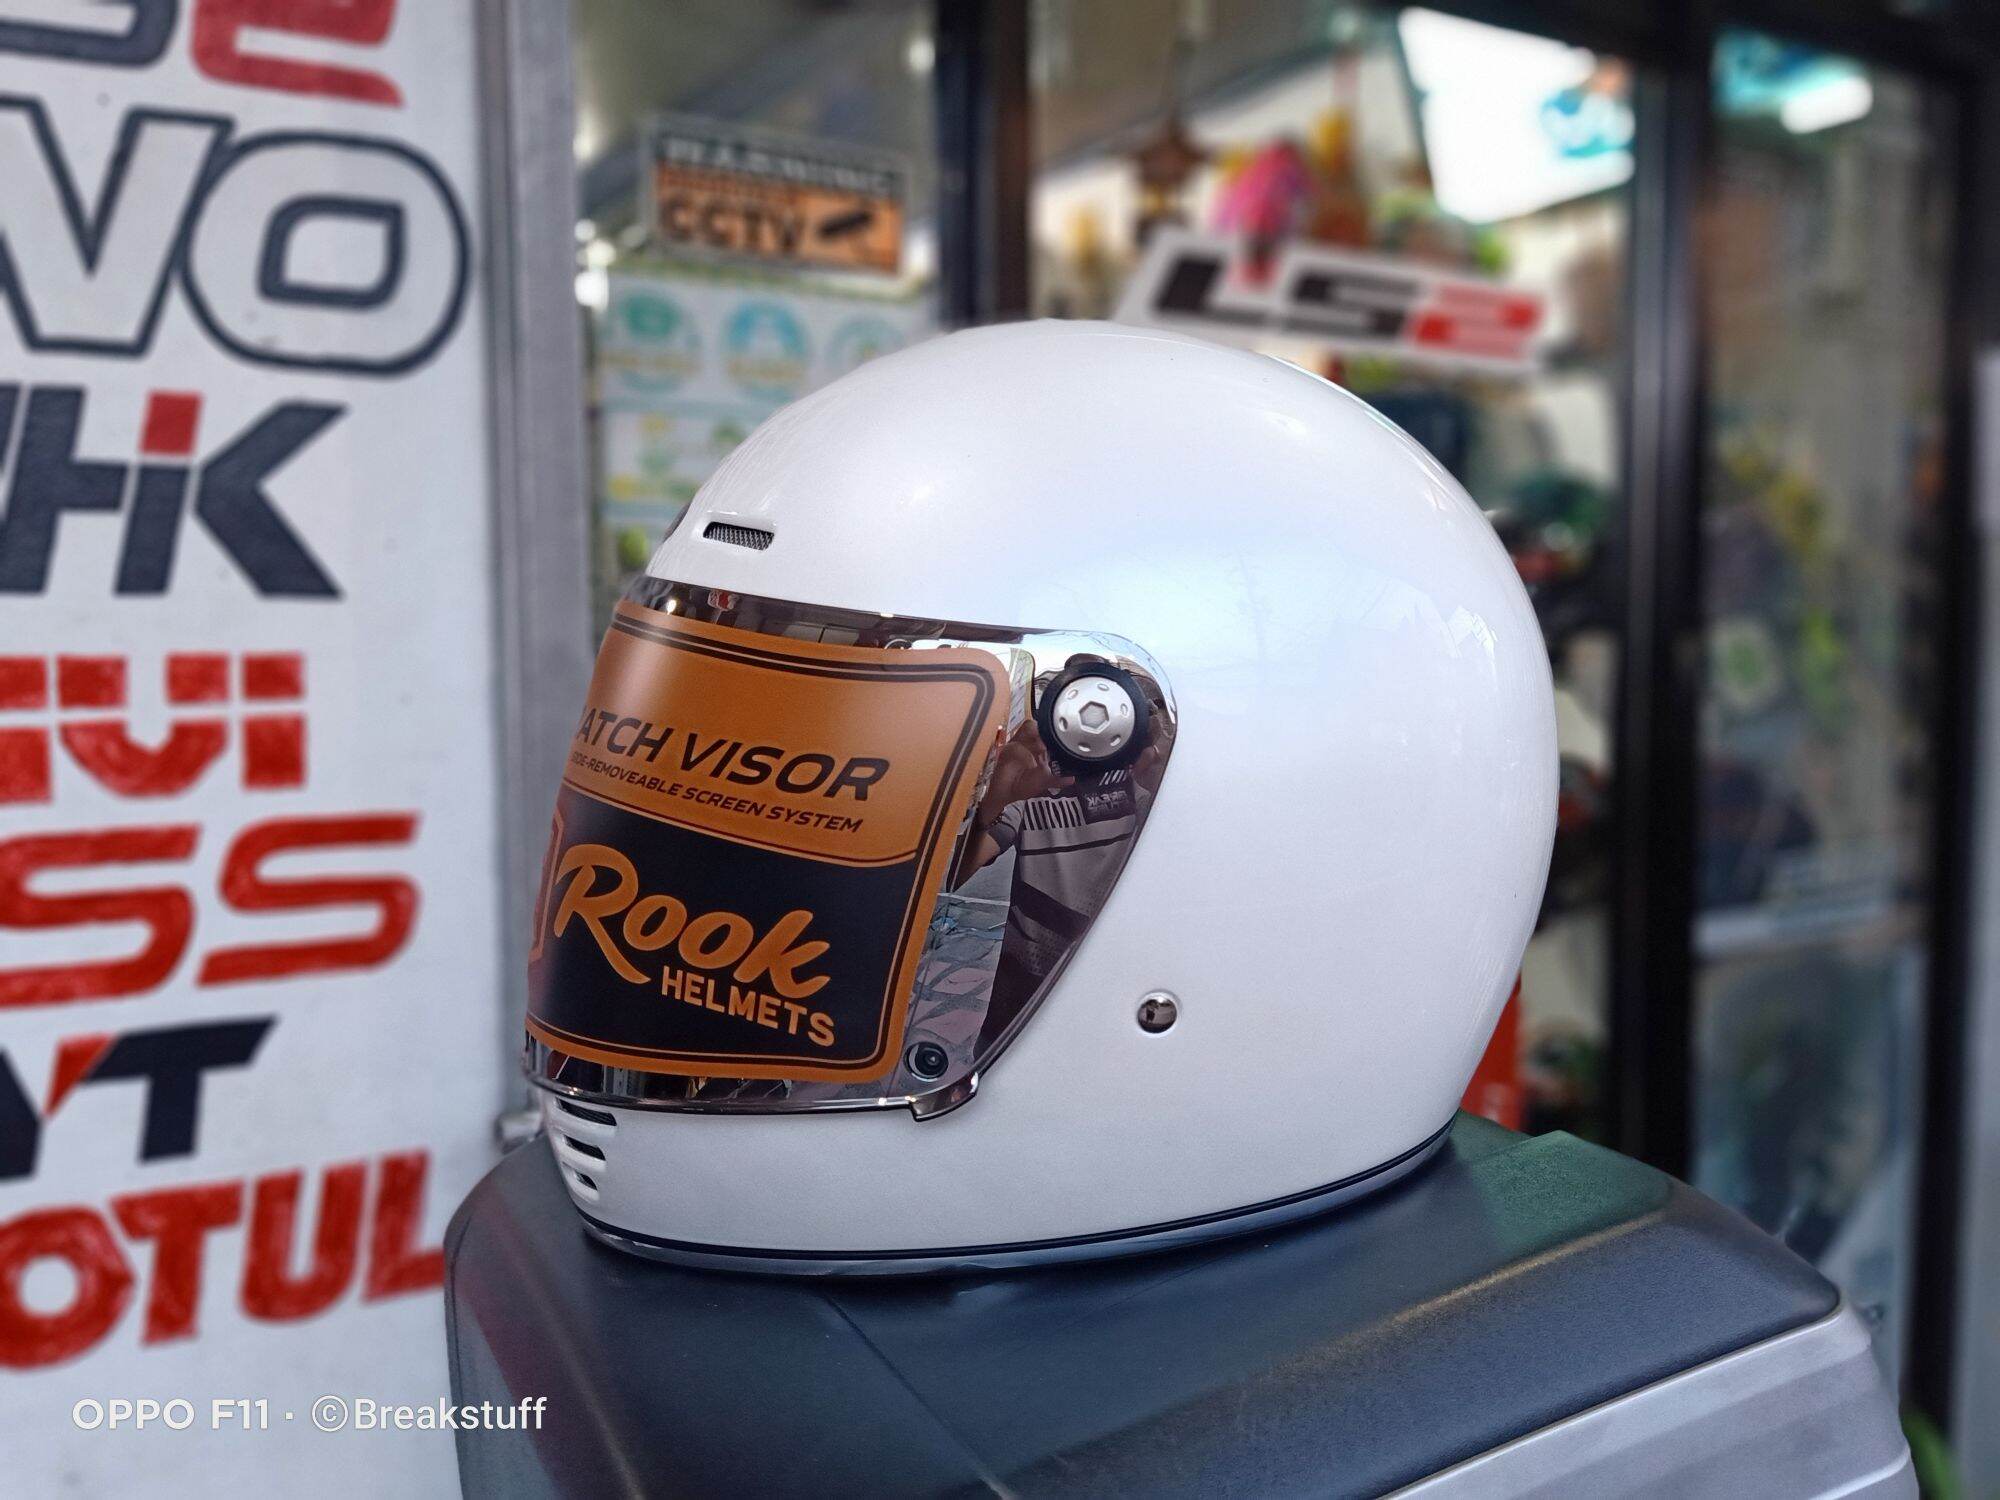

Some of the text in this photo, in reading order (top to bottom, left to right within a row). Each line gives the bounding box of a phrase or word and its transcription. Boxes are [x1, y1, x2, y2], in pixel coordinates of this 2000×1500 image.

[660, 195, 806, 255] CCTV
[1150, 250, 1545, 360] LS2
[0, 383, 350, 599] HK
[577, 705, 890, 802] ATCH VISOR
[682, 786, 767, 817] SCREEN
[765, 804, 864, 834] SYSTEM
[552, 843, 832, 999] Rook
[660, 964, 836, 1048] HELMETS
